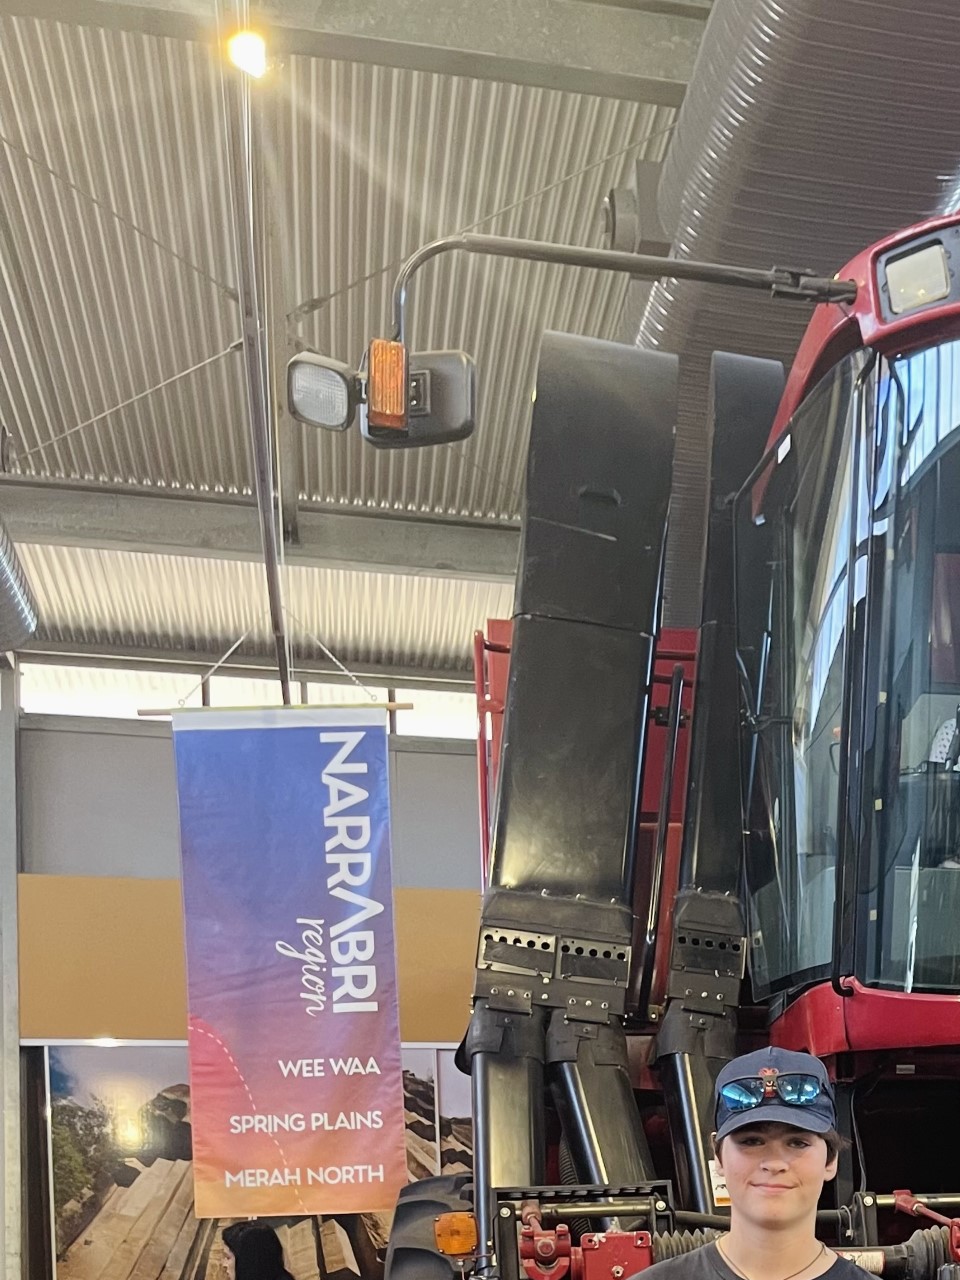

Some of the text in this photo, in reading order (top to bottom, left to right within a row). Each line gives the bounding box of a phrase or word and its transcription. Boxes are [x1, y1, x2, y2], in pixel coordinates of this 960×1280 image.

[319, 731, 385, 1013] NARRABRI
[275, 915, 325, 1018] region
[278, 1057, 381, 1078] WEE WAA
[229, 1110, 383, 1134] SPRING PLAINS
[225, 1164, 384, 1188] MERAH NORTH
